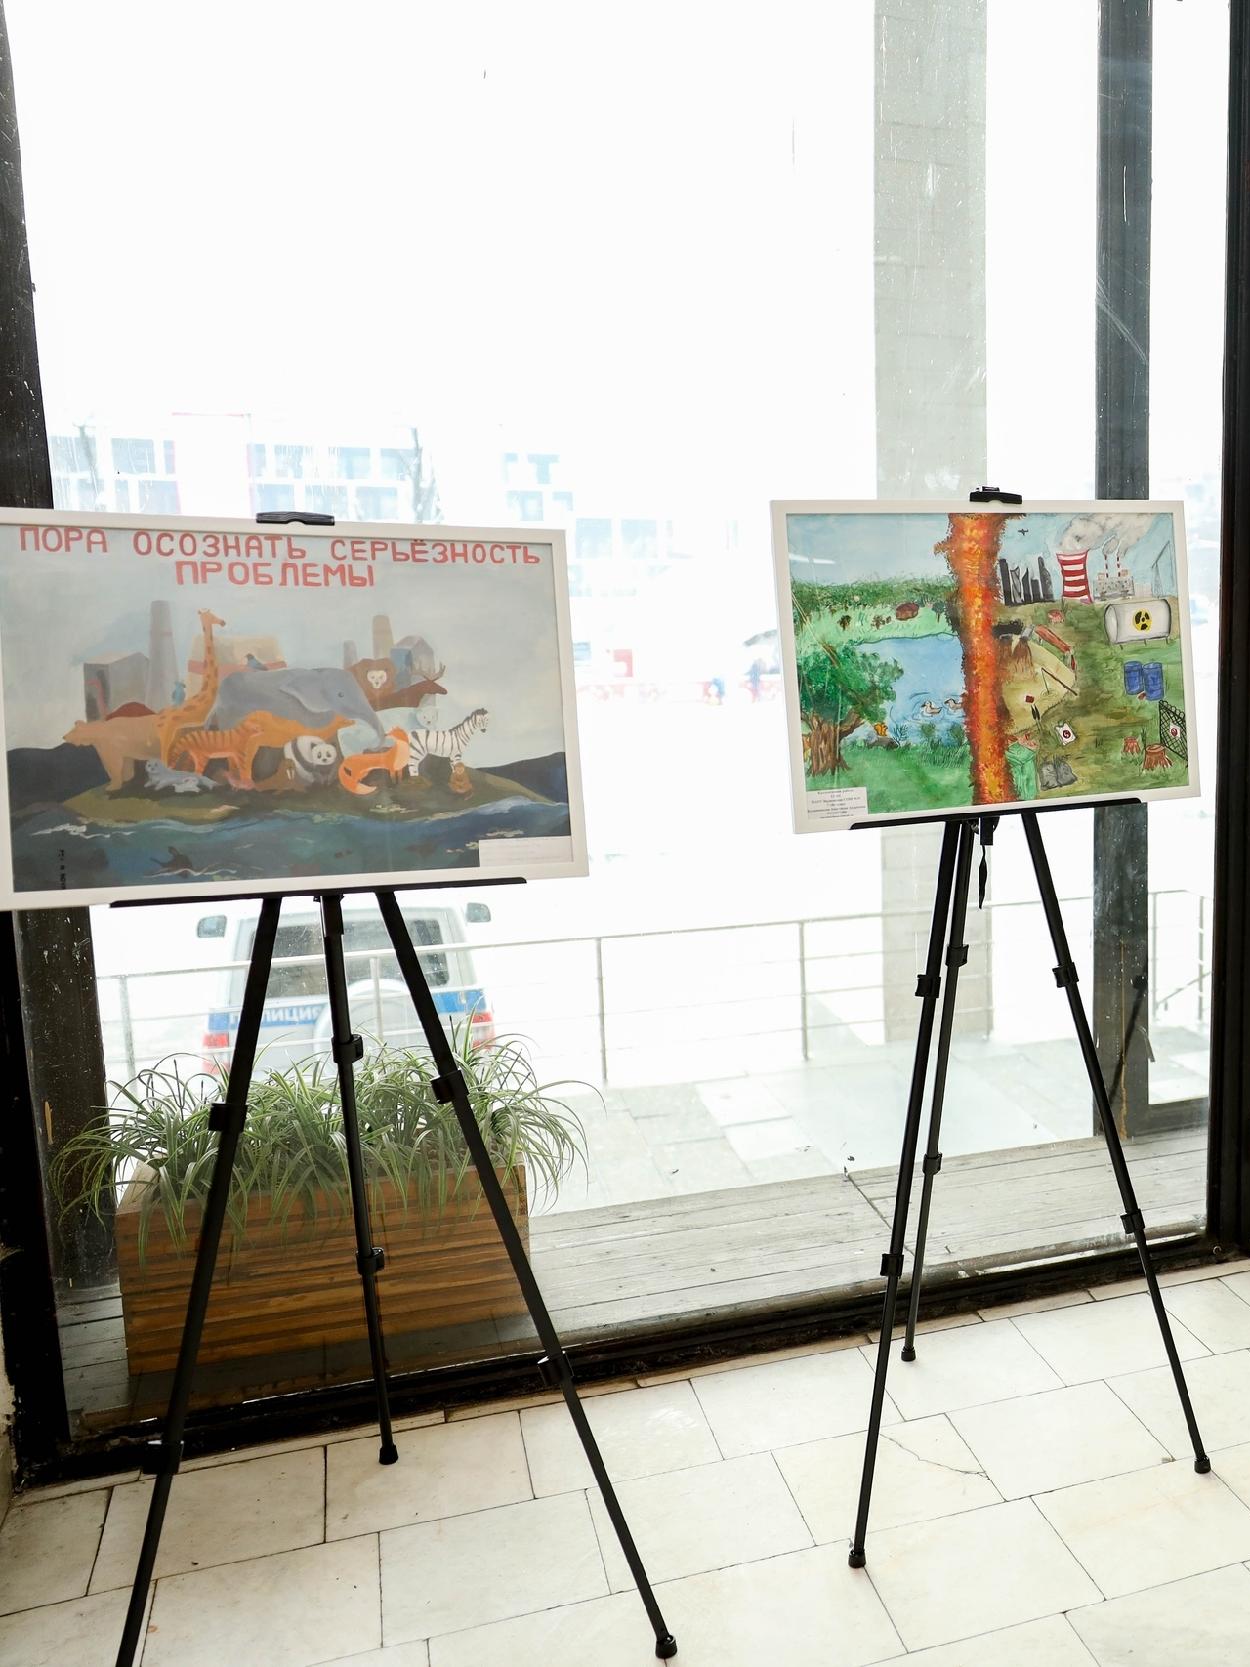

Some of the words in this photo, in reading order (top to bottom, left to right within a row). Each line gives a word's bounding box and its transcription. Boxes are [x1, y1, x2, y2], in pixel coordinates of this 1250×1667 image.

[19, 526, 109, 554] ПОРА
[132, 529, 307, 560] ОСОЗНАТЬ
[330, 538, 541, 564] СЕРЬЁЗНОСТЬ
[174, 560, 375, 588] ПРОБЛЕМЫ
[229, 1006, 323, 1026] ПЛИЦИЯ
